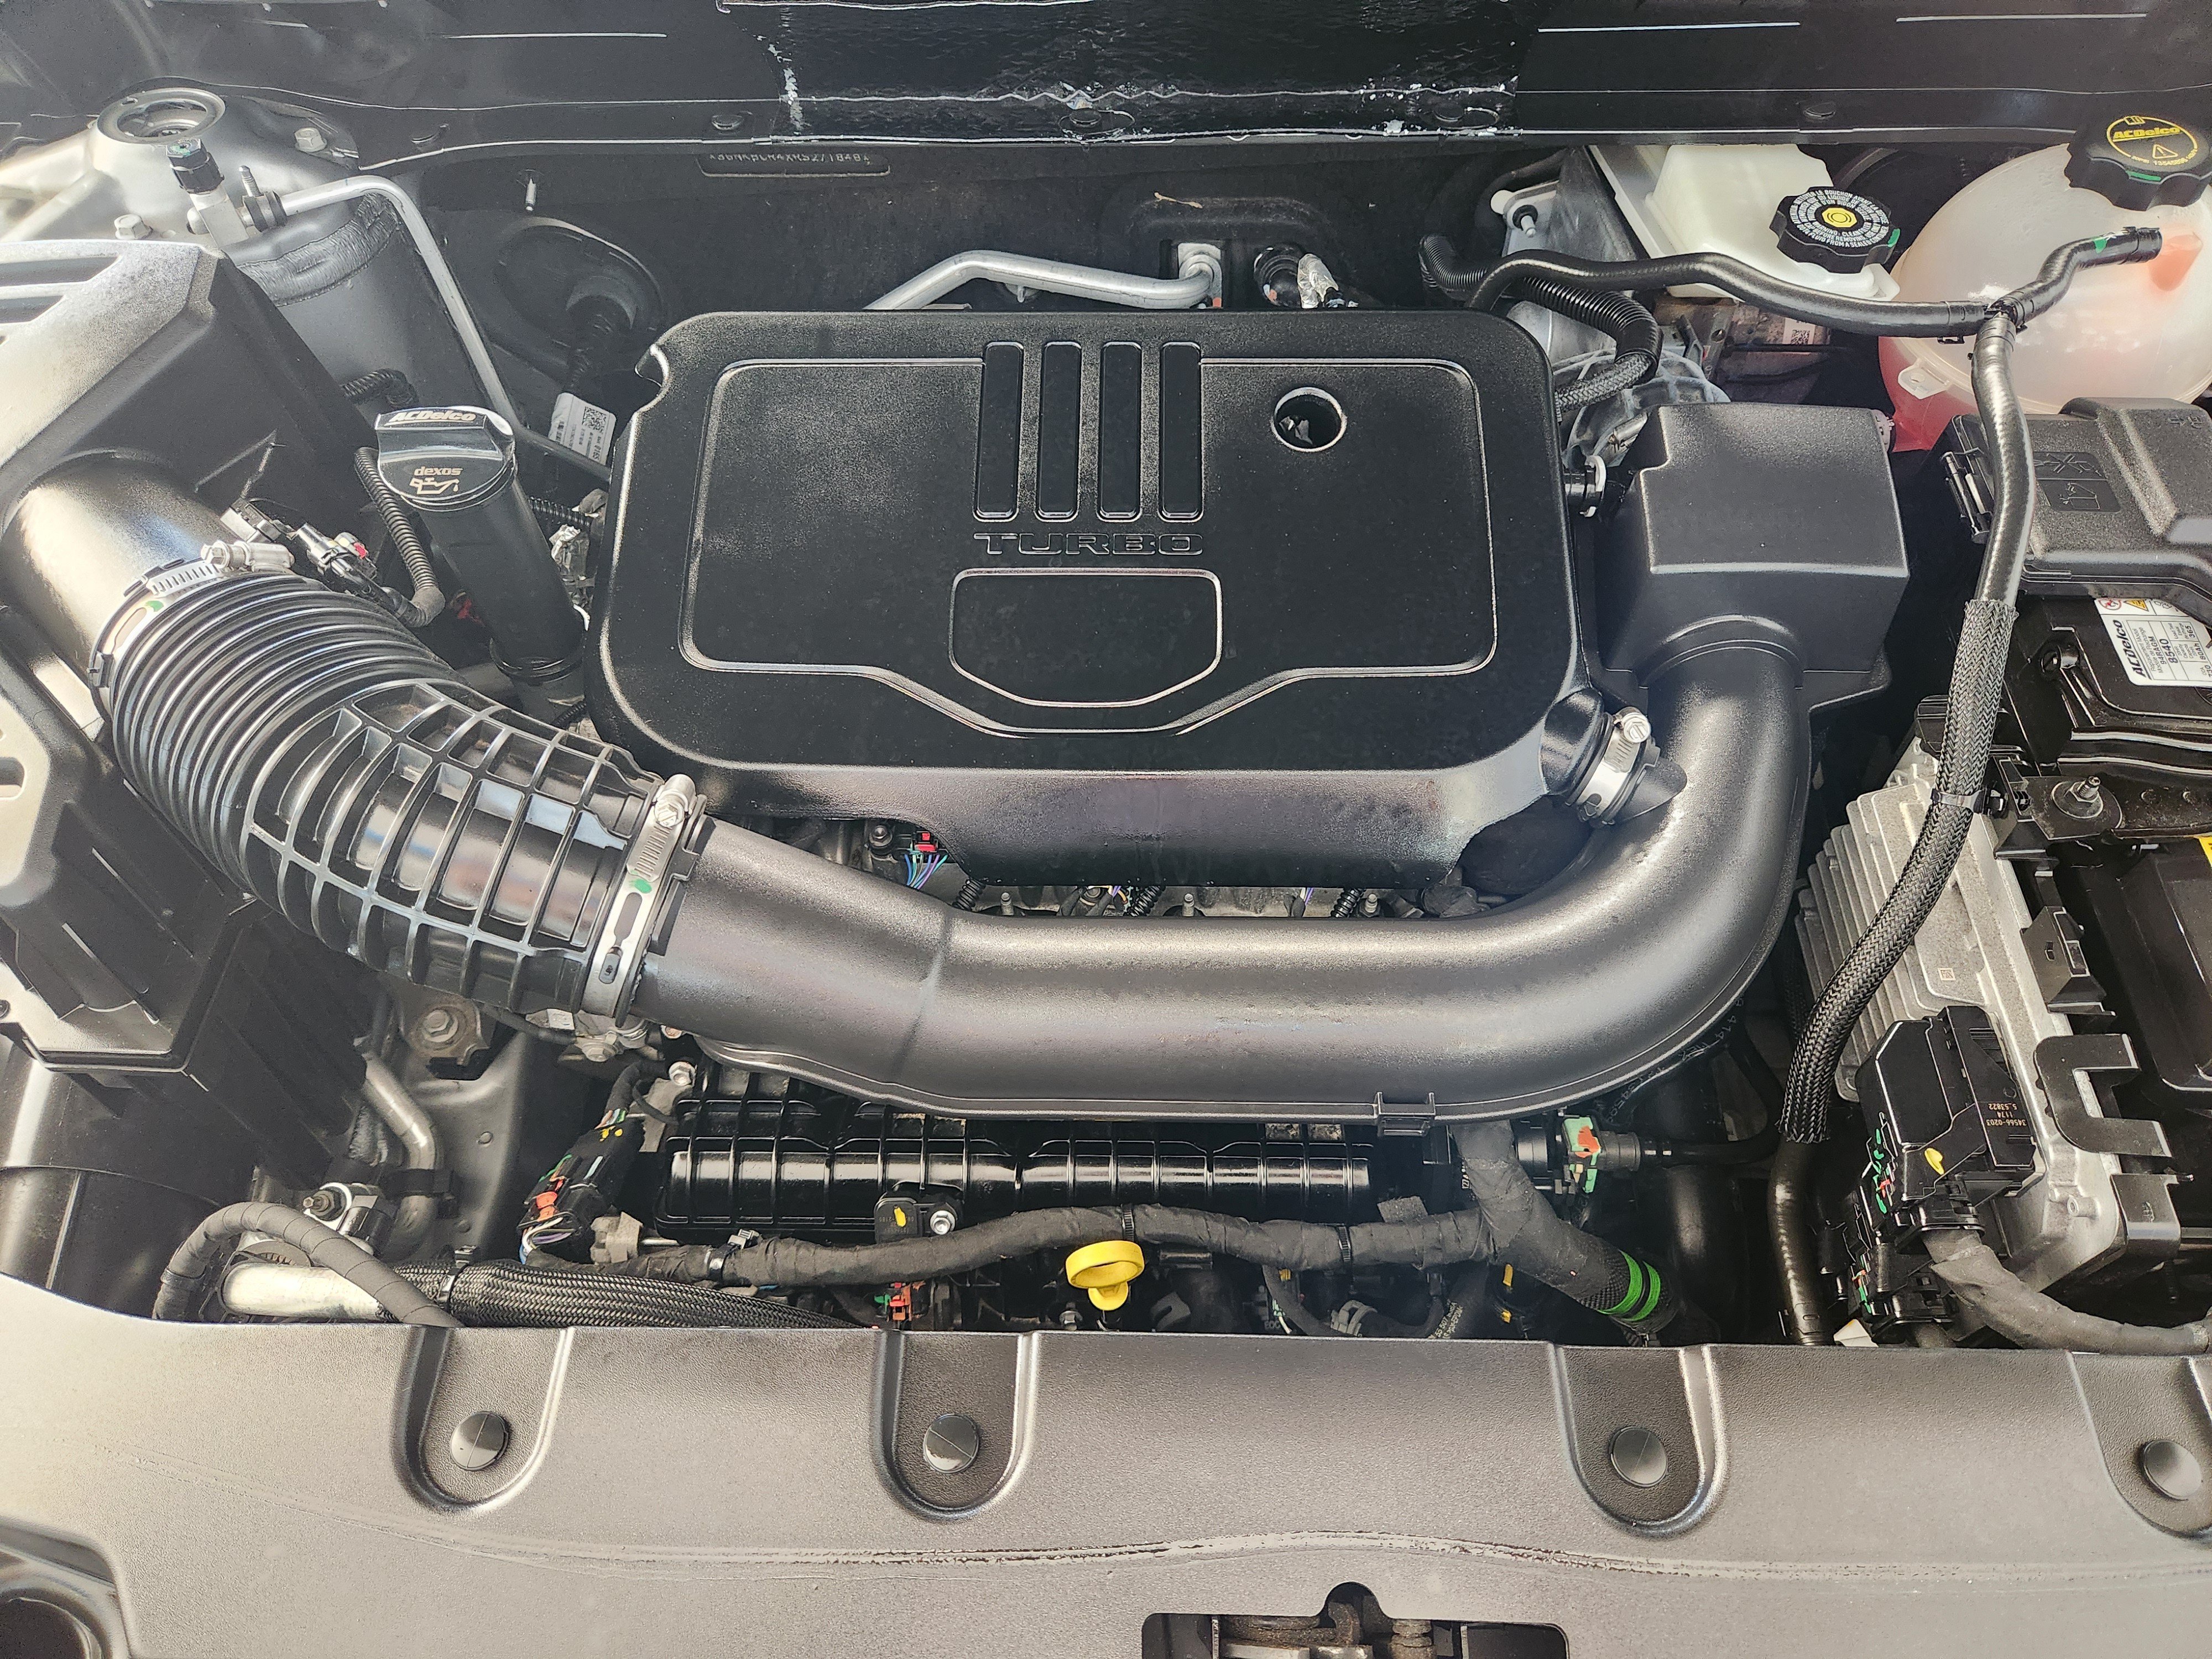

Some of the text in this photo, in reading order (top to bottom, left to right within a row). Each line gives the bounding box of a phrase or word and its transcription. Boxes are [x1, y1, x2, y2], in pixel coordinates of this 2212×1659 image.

[2113, 127, 2180, 139] ACDelco
[1813, 228, 1835, 239] BEFORE
[388, 410, 477, 422] ACDelco
[414, 466, 463, 476] dexos
[973, 533, 1203, 555] TURBO
[2185, 625, 2195, 638] 365
[2112, 619, 2146, 677] ACDelco
[2148, 636, 2167, 664] 94RAGM
[2159, 639, 2178, 663] 8540
[2194, 643, 2206, 660] 80Ah
